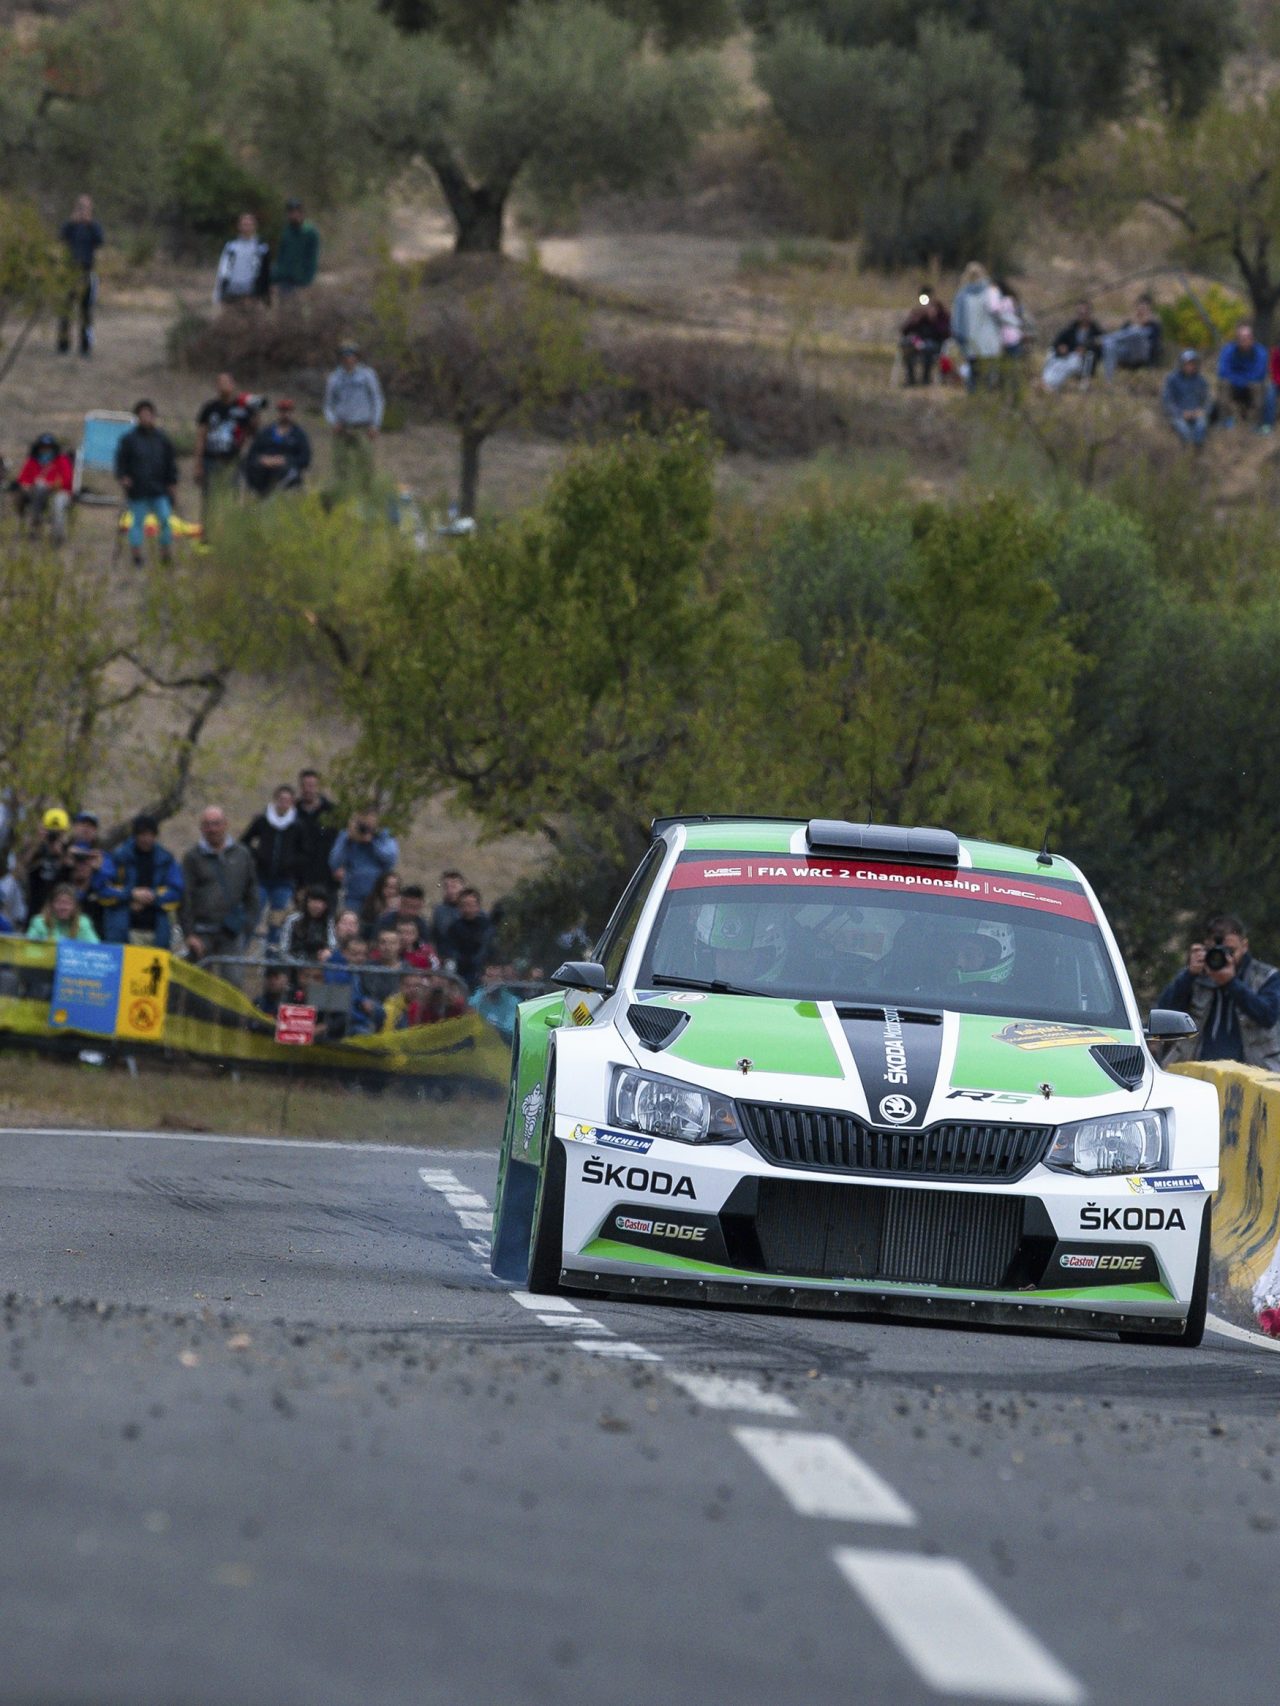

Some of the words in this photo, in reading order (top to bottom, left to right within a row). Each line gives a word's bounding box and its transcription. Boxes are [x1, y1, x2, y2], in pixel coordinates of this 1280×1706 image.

[758, 867, 787, 876] FIA
[792, 867, 833, 878] WRC
[839, 869, 851, 878] 2
[856, 869, 981, 893] Championship
[883, 1039, 908, 1085] ŠKODA
[945, 1090, 1033, 1104] R5
[601, 1134, 652, 1149] MICHELIN
[582, 1155, 697, 1200] ŠKODA
[1153, 1178, 1201, 1188] MICHELIN
[1079, 1202, 1187, 1231] ŠKODA
[624, 1218, 650, 1232] Castrol
[652, 1222, 709, 1241] EDGE
[1069, 1256, 1096, 1268] Castrol
[1098, 1256, 1147, 1270] EDGE
